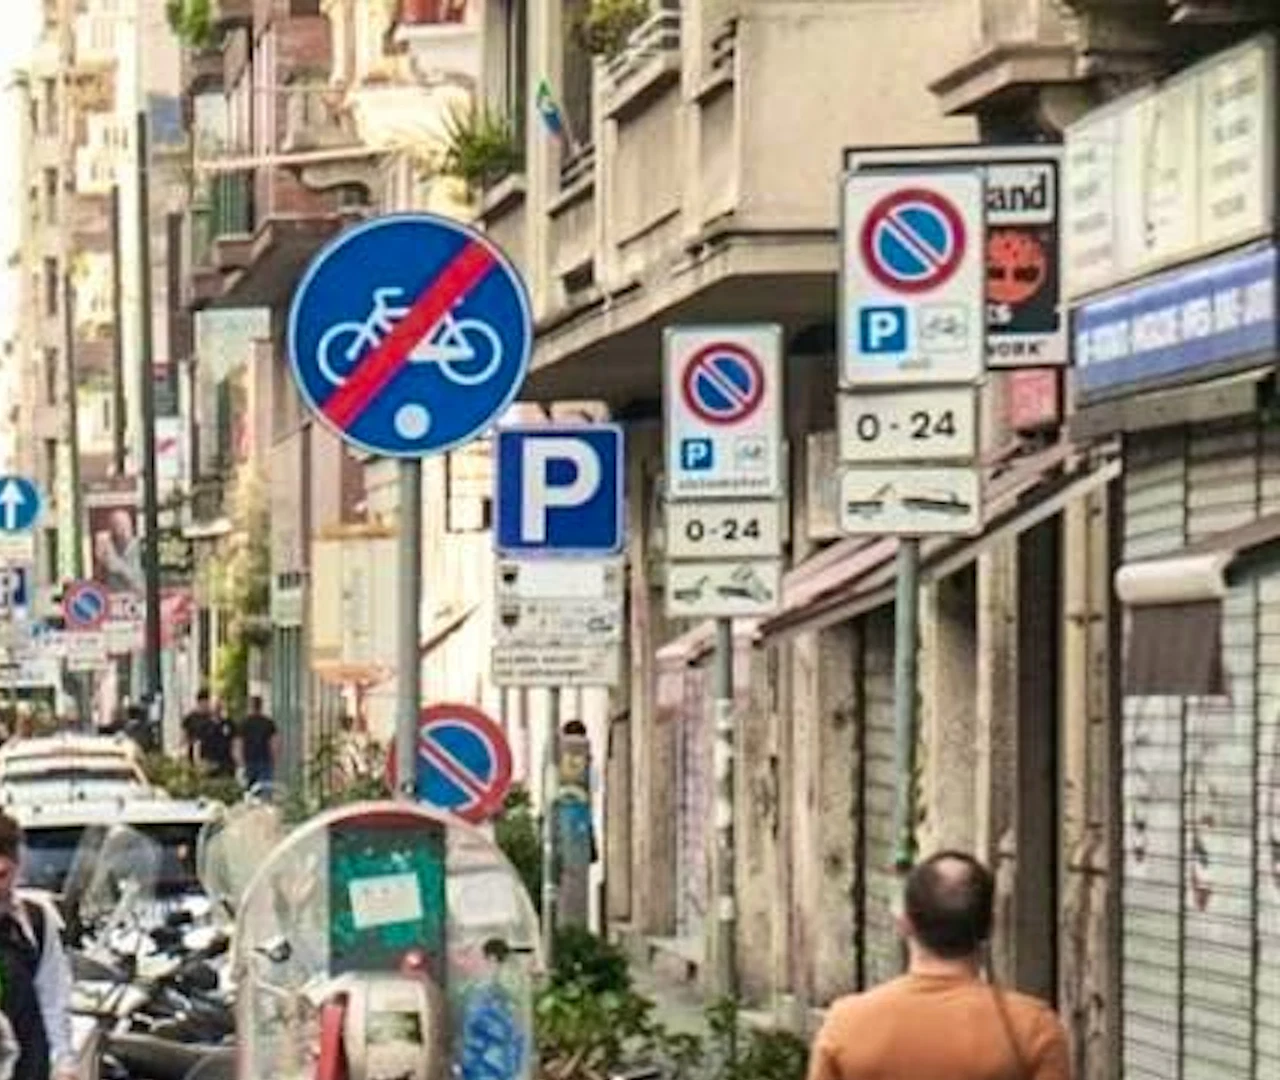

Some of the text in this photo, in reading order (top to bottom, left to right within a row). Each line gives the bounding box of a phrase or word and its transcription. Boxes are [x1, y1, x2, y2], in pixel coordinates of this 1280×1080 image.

[988, 173, 1047, 210] and
[867, 312, 898, 349] P
[910, 410, 956, 439] 24
[686, 443, 707, 467] P
[521, 437, 601, 542] P
